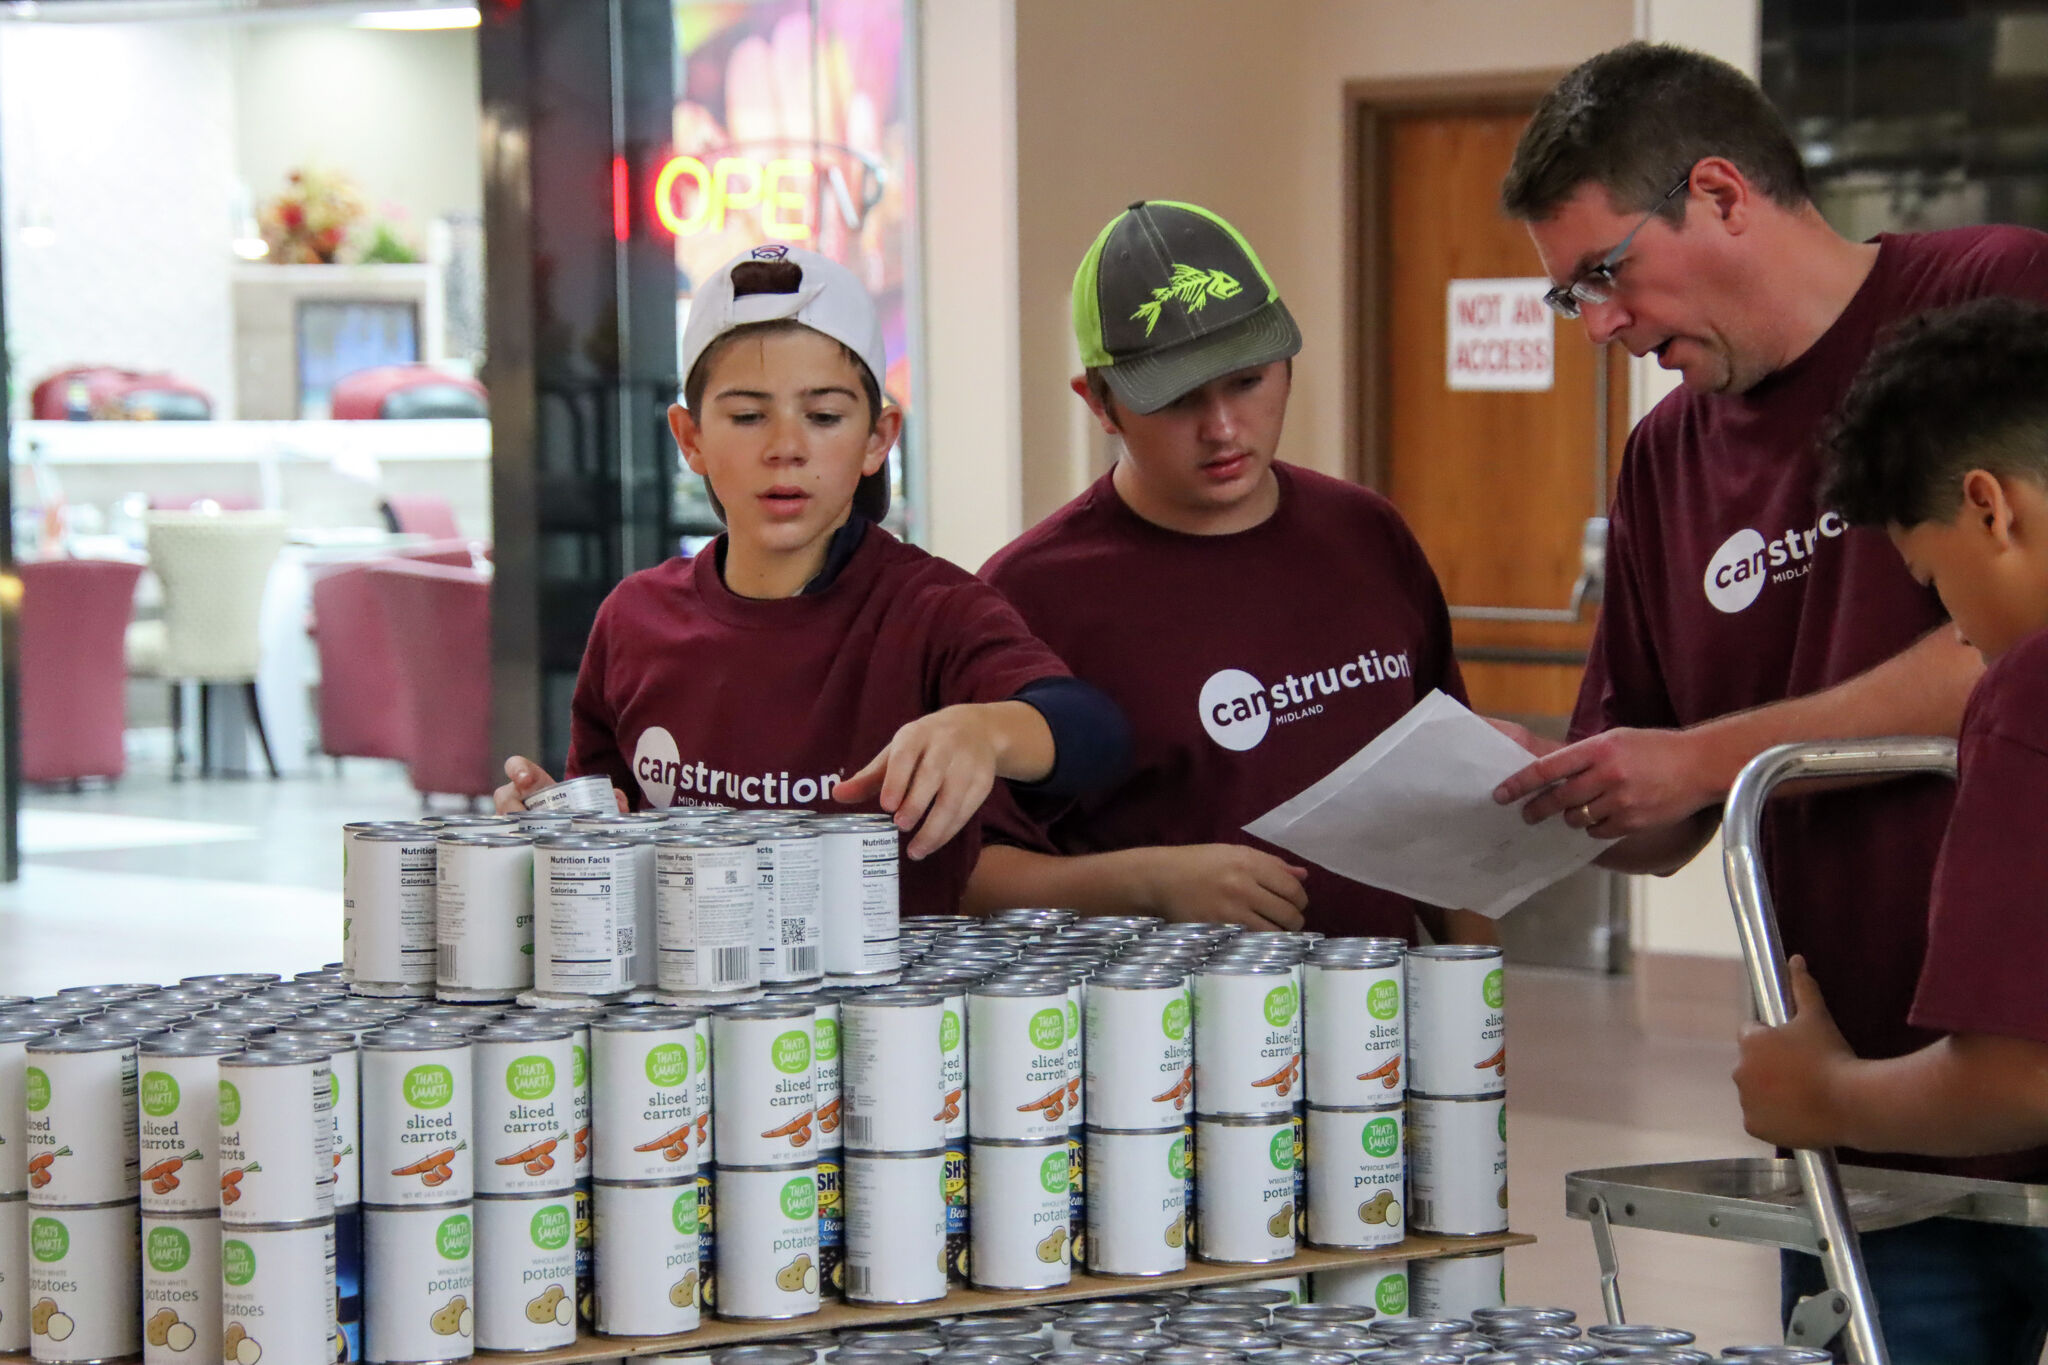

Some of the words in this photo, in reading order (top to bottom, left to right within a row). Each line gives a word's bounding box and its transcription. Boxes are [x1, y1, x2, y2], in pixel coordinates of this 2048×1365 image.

[654, 155, 866, 240] OPEN
[1457, 293, 1502, 326] NOT
[1514, 295, 1544, 324] AN
[1455, 338, 1553, 373] ACCESS
[1212, 649, 1411, 727] canstruction
[1275, 704, 1324, 726] MIDLAND
[762, 875, 773, 883] 70
[600, 885, 610, 893] 70
[412, 1071, 444, 1084] THAT'S
[515, 1063, 546, 1076] THAT'S
[410, 1083, 449, 1100] SMART!
[513, 1074, 551, 1092] SMART!
[775, 1076, 811, 1093] sliced
[648, 1089, 688, 1107] sliced
[509, 1102, 554, 1120] sliced
[643, 1106, 692, 1121] carrots
[406, 1112, 452, 1130] sliced
[504, 1119, 560, 1134] carrots
[401, 1129, 457, 1144] carrots
[1360, 1164, 1384, 1172] WHOLE
[539, 1212, 565, 1226] THAT'S
